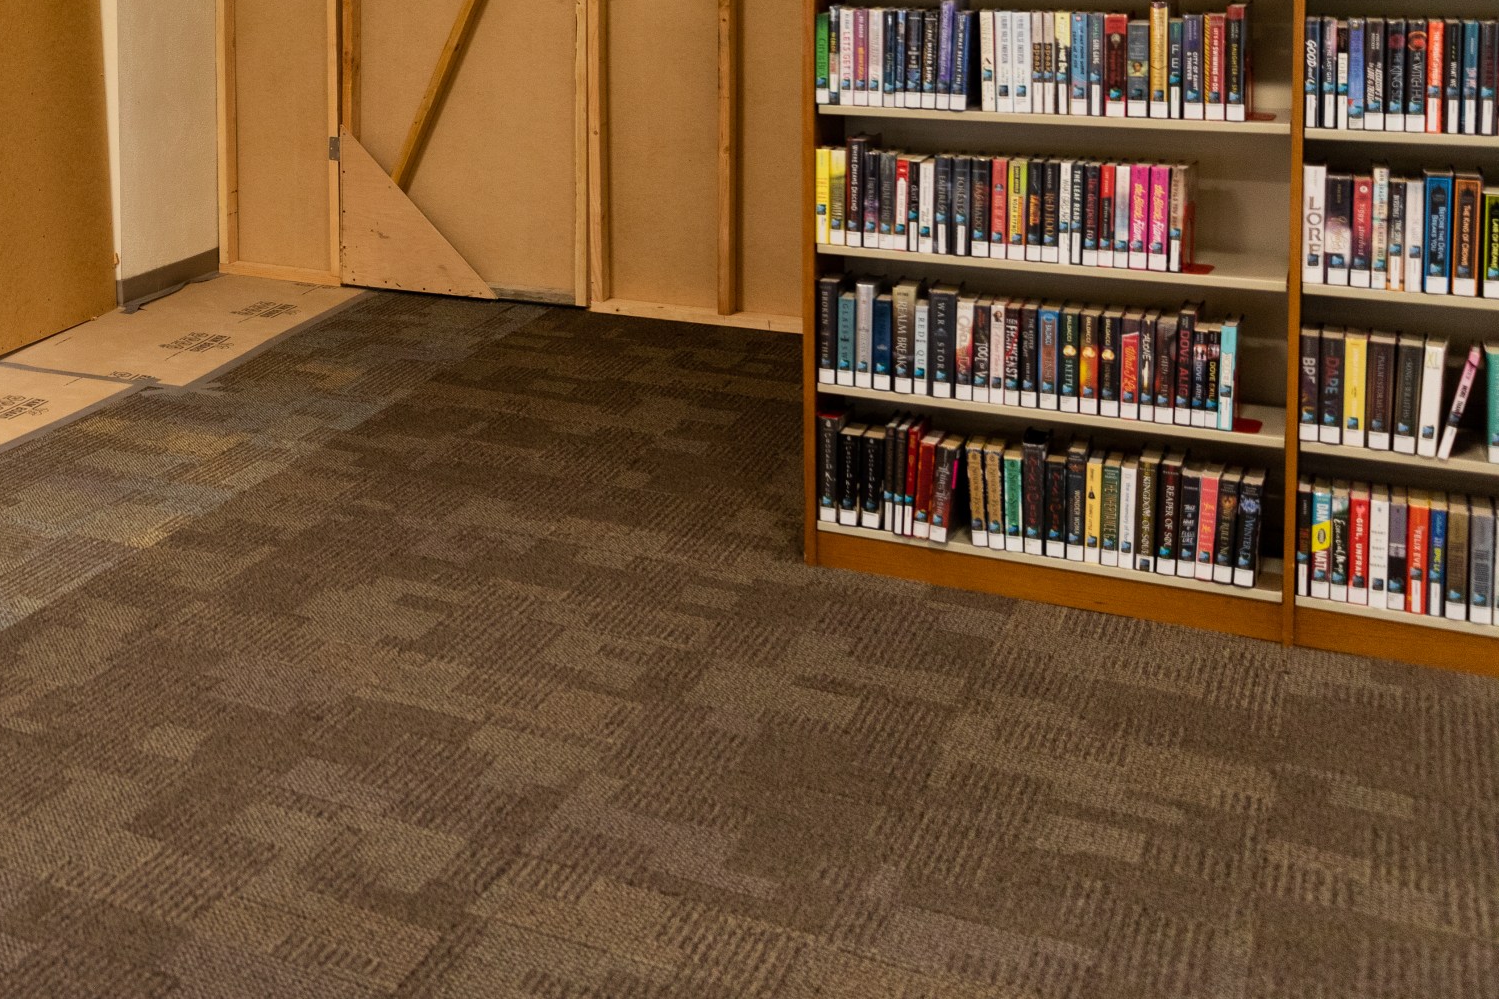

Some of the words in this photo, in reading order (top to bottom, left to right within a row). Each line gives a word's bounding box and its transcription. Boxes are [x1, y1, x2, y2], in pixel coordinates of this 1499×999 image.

[843, 54, 851, 69] GET
[1212, 46, 1220, 75] SWIMMING
[1305, 39, 1318, 68] GOOD
[1389, 64, 1403, 87] KING
[1411, 63, 1423, 87] WITCH
[1450, 61, 1458, 77] WHAT
[1449, 78, 1457, 87] WE
[851, 164, 859, 185] DREAMS
[1073, 170, 1081, 183] THE
[1073, 185, 1081, 200] LEAF
[1086, 193, 1097, 228] deepest
[1437, 206, 1447, 228] BEFORE
[1462, 204, 1472, 216] THE
[1430, 214, 1439, 238] BREAKS
[1437, 230, 1446, 241] THE
[1461, 217, 1472, 233] KING
[1430, 239, 1439, 253] YOU
[1461, 234, 1470, 242] OF
[1436, 242, 1446, 260] DEVIL
[1461, 243, 1471, 267] CROWS
[821, 291, 829, 325] BROKEN
[896, 300, 908, 334] REALM
[936, 302, 946, 325] WAR
[917, 316, 926, 338] RED
[1045, 324, 1053, 345] BALDACCI
[1104, 318, 1112, 346] BALDACCI
[936, 341, 945, 369] STOR
[1179, 329, 1191, 364] DOVE
[1195, 361, 1203, 381] DOVE
[1209, 361, 1217, 381] DOVE
[1073, 490, 1082, 516] WONDER
[1142, 475, 1152, 517] KINGDOM
[1164, 485, 1175, 517] REAPER
[1316, 502, 1328, 522] DAN
[1141, 519, 1151, 531] OF
[1164, 518, 1173, 530] OF
[1241, 518, 1257, 551] WINTER
[1356, 517, 1365, 541] GIRL,
[1413, 529, 1422, 551] FELIX
